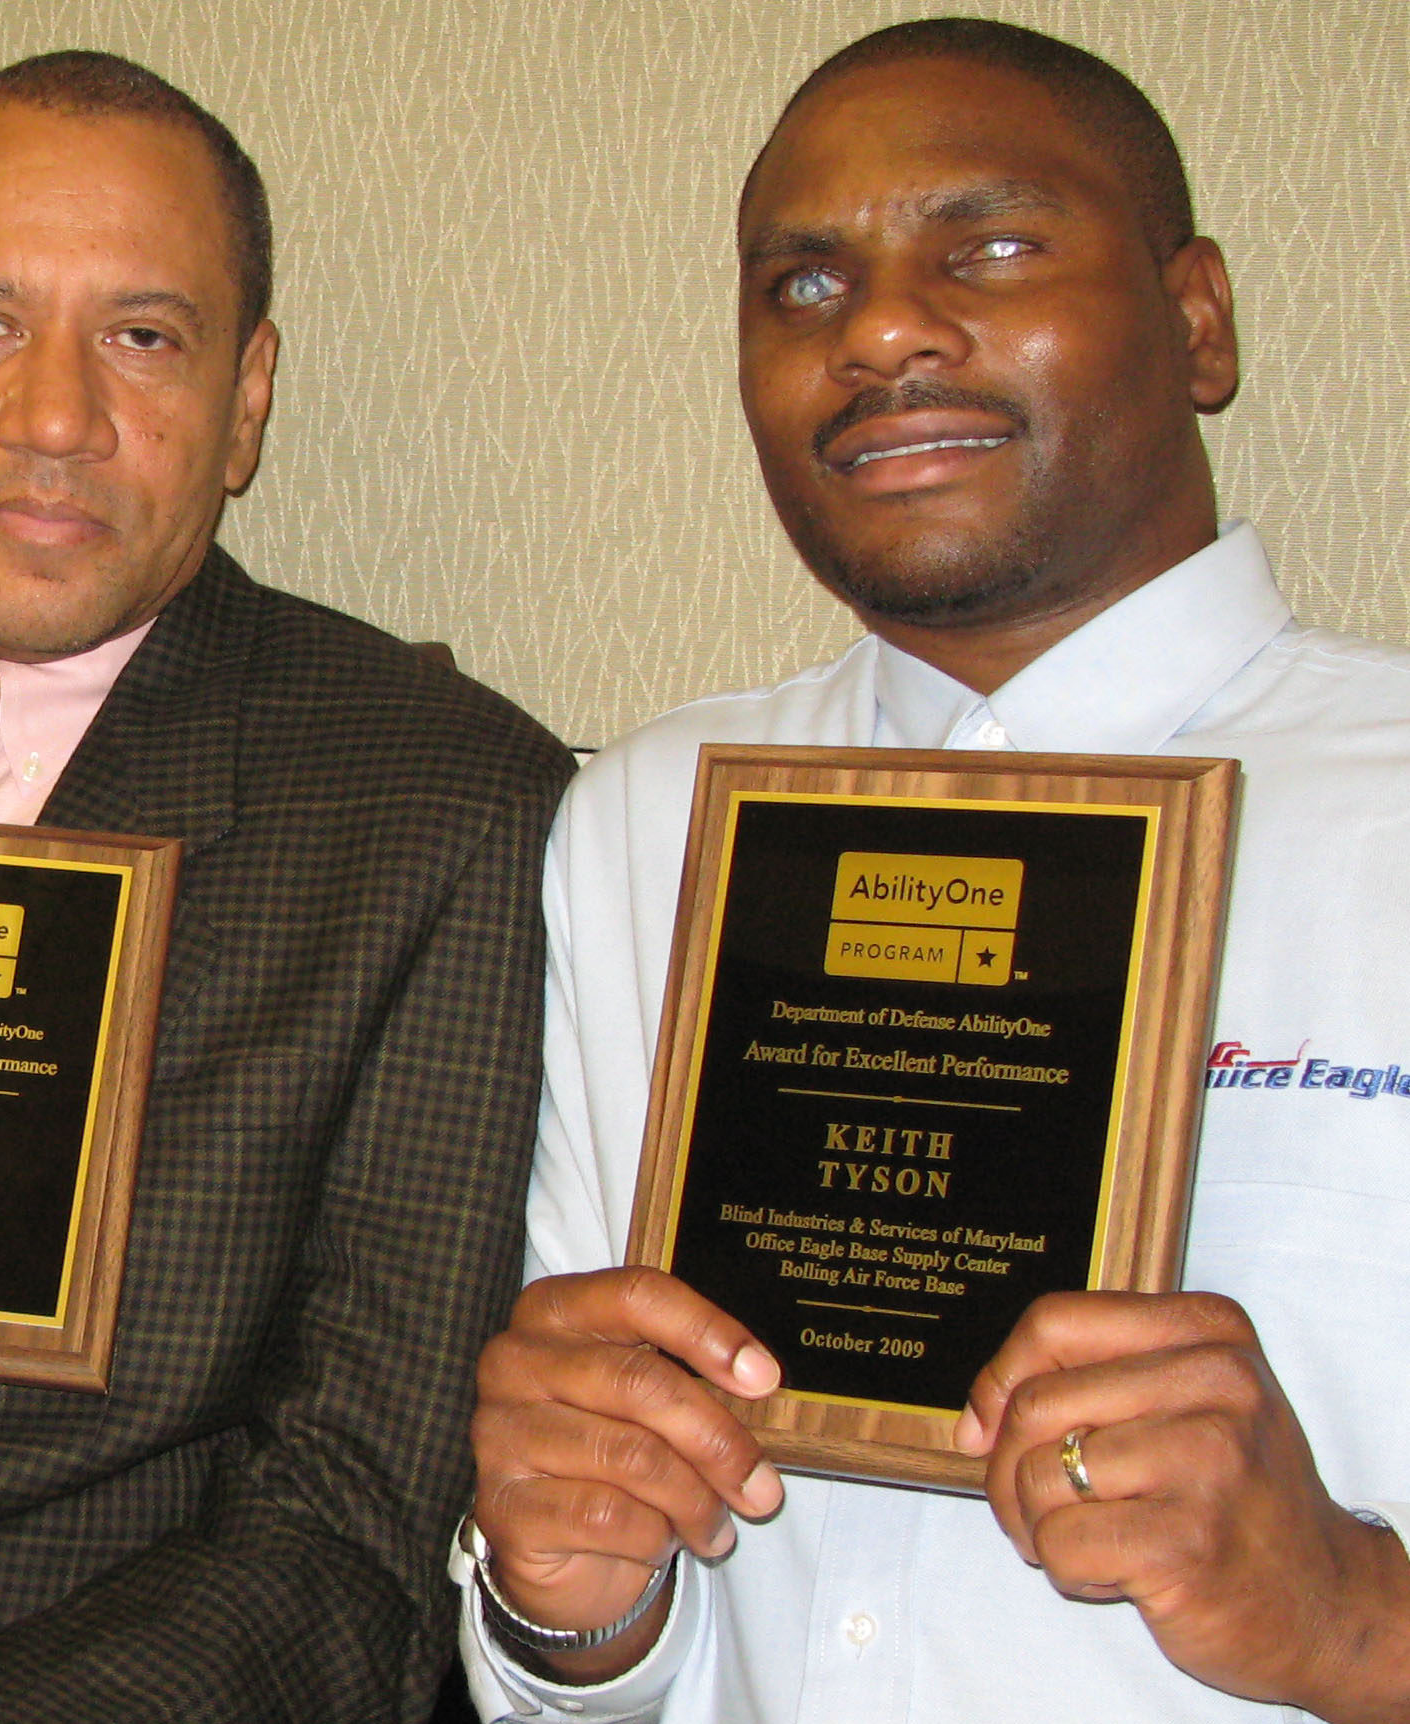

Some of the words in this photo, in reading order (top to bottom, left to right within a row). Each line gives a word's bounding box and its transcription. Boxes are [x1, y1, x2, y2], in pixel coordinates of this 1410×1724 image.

[849, 873, 1004, 911] AbilityOne
[840, 942, 944, 963] PROGRAM
[771, 1000, 864, 1024] Department
[868, 1008, 889, 1026] of
[889, 1009, 955, 1030] Defense
[957, 1014, 1051, 1039] AbilityOne
[743, 1040, 807, 1064] Award
[811, 1044, 840, 1066] for
[843, 1047, 936, 1074] Excellent
[940, 1053, 1070, 1084] Performance
[1205, 1042, 1294, 1089] ffice
[823, 1123, 954, 1160] KEITH
[818, 1161, 951, 1198] TYSON
[720, 1204, 763, 1225] Blind
[767, 1208, 845, 1233] Industries
[849, 1217, 865, 1234] &
[869, 1218, 937, 1242] Services
[942, 1227, 962, 1244] of
[964, 1228, 1045, 1253] Maryland
[745, 1231, 795, 1252] Office
[799, 1236, 844, 1261] Eagle
[849, 1242, 889, 1263] Base
[892, 1246, 950, 1271] Supply
[954, 1253, 1011, 1275] Center
[780, 1260, 840, 1286] Bolling
[844, 1268, 871, 1286] Air
[873, 1270, 920, 1292] Force
[925, 1276, 966, 1295] Base
[800, 1328, 873, 1353] October
[878, 1337, 925, 1359] 2009
